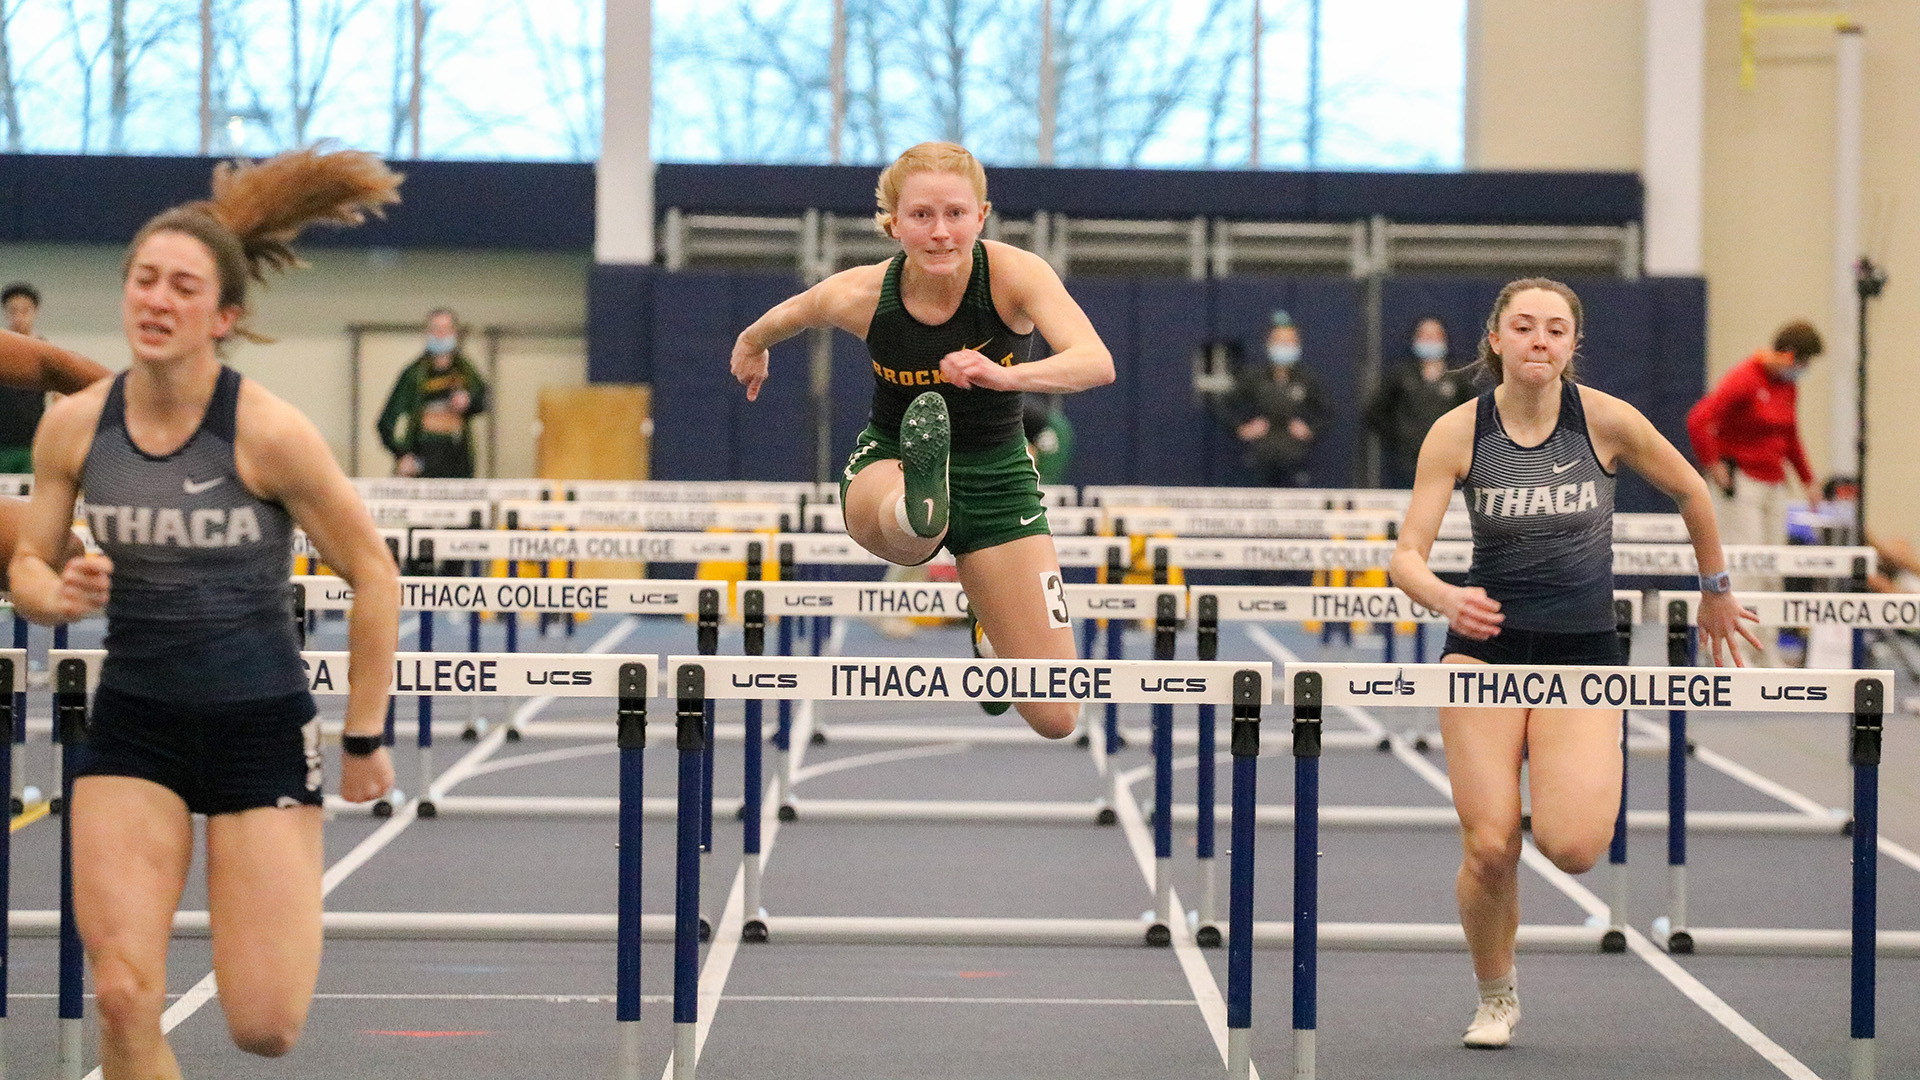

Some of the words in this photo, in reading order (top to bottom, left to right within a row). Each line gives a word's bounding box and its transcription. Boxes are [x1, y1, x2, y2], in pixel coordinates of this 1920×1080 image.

[872, 352, 1014, 386] BROCKT
[1473, 480, 1599, 517] ITHACA
[85, 504, 261, 547] THACA
[508, 537, 579, 556] ITHACA
[586, 538, 675, 558] COLLEGE
[400, 583, 488, 608] ITHACA
[496, 584, 609, 609] COLLEGE
[629, 593, 679, 605] UCS
[784, 595, 834, 607] UCS
[858, 589, 946, 613] ITHACA
[1087, 598, 1137, 609] UCS
[1238, 600, 1288, 612] UCS
[1311, 595, 1401, 619] ITHACA
[1783, 600, 1872, 624] ITHACA
[396, 660, 497, 692] LLEGE
[526, 670, 593, 686] UCS
[732, 672, 798, 689] UCS
[831, 664, 949, 698] ITHACA
[962, 665, 1112, 699] COLLEGE
[1140, 677, 1208, 694] UCS
[1448, 672, 1568, 705] ITHACA
[1580, 674, 1732, 707] COLLEGE
[1760, 685, 1829, 702] UCS
